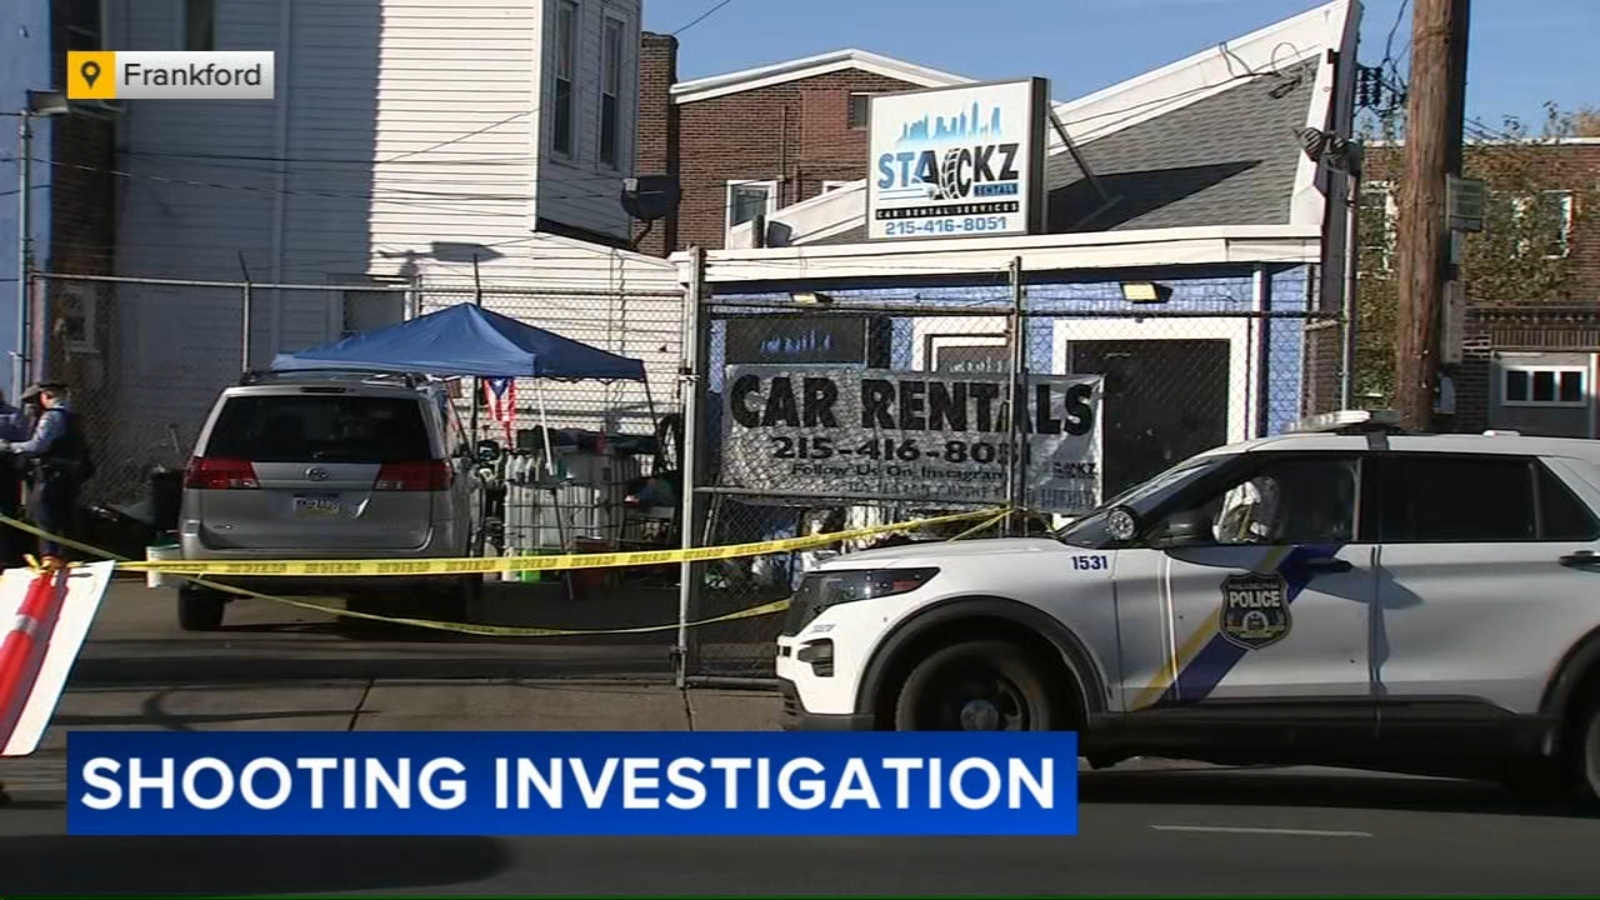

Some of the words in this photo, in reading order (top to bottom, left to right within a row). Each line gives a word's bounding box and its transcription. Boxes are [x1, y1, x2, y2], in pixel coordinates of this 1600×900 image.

[878, 143, 1019, 199] STACKZ
[877, 209, 898, 219] CAR
[905, 206, 949, 216] RENTAL
[957, 202, 1017, 213] SERVICES
[885, 216, 1007, 235] 215-416-8051
[730, 374, 839, 429] CAR
[861, 378, 1093, 436] RENTALS
[792, 463, 848, 475] Follow
[856, 464, 879, 476] Us
[921, 466, 1008, 482] Instagram
[1071, 555, 1108, 570] 1531
[1229, 590, 1281, 608] POLICE
